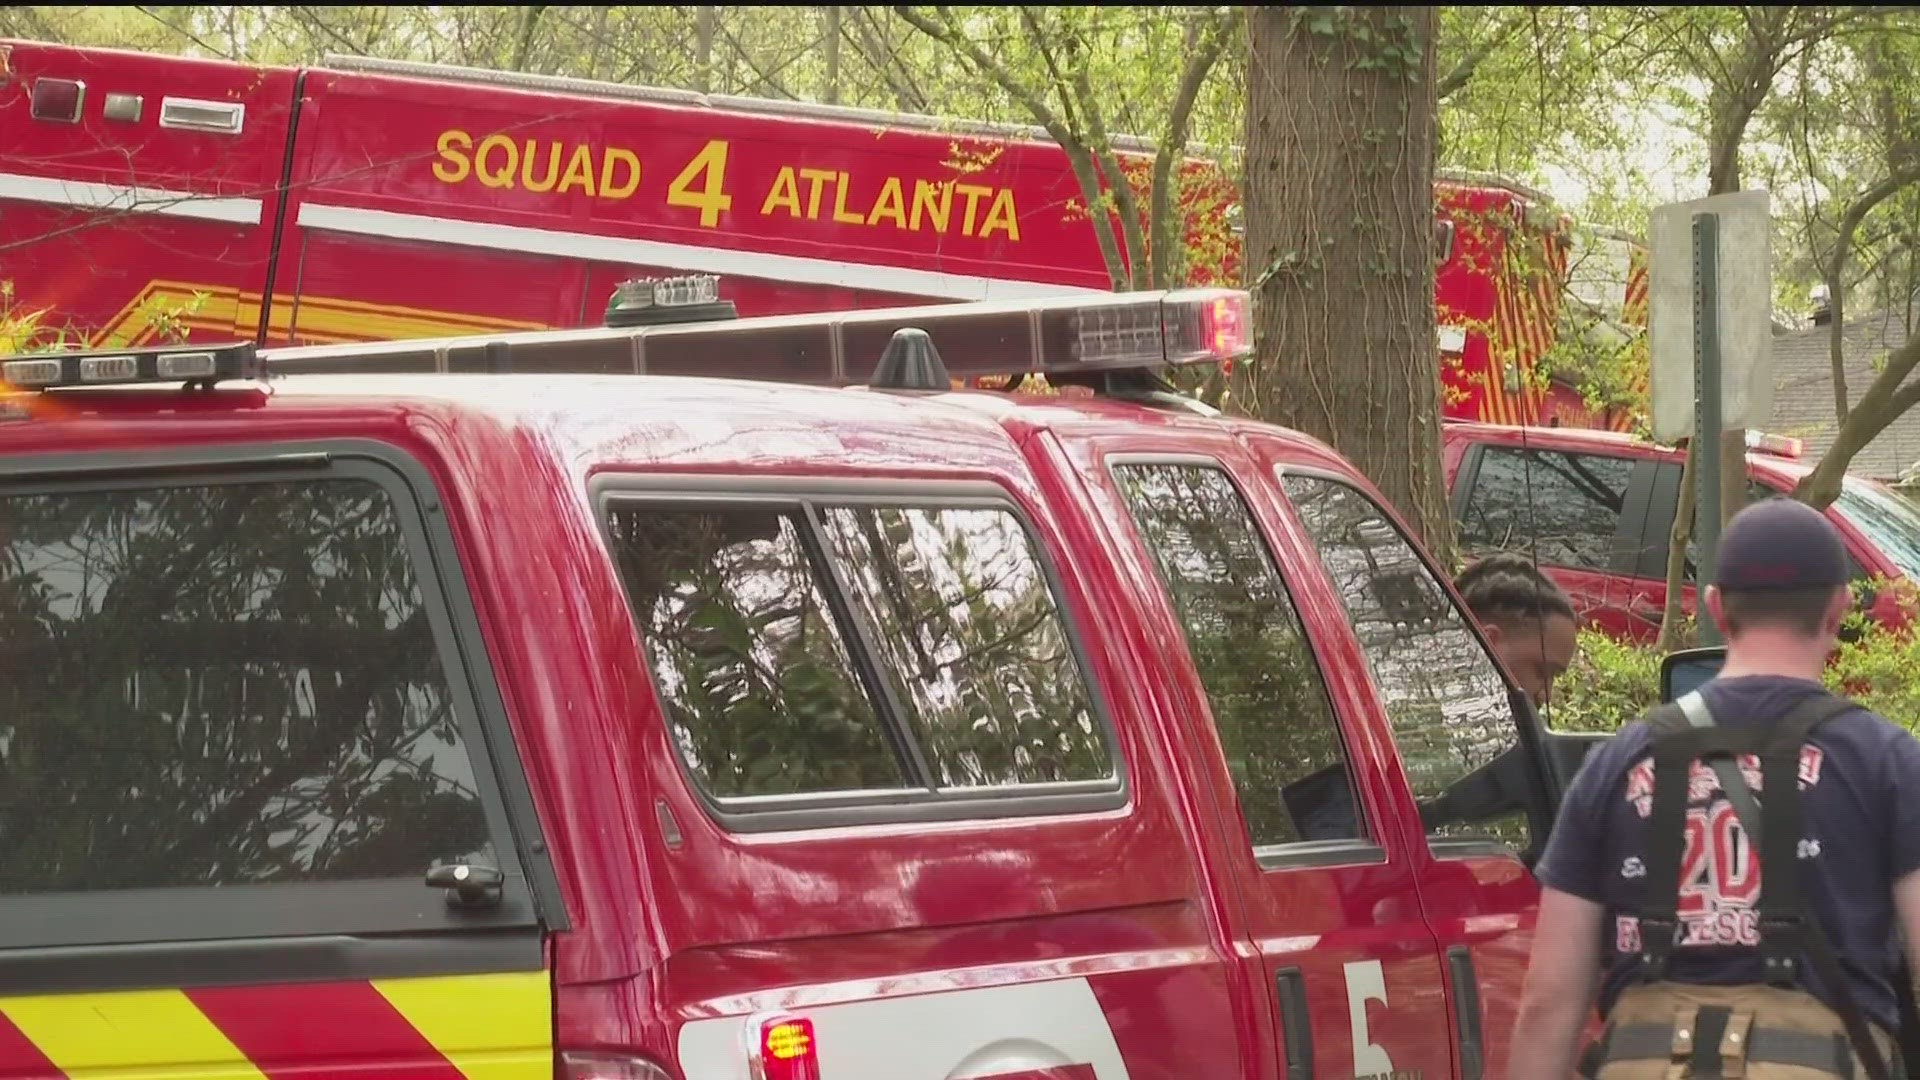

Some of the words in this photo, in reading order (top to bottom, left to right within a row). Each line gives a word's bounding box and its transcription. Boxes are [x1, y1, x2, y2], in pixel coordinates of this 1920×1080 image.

[431, 129, 642, 198] SQUAD
[666, 139, 732, 227] 4
[759, 165, 1021, 241] ATLANTA
